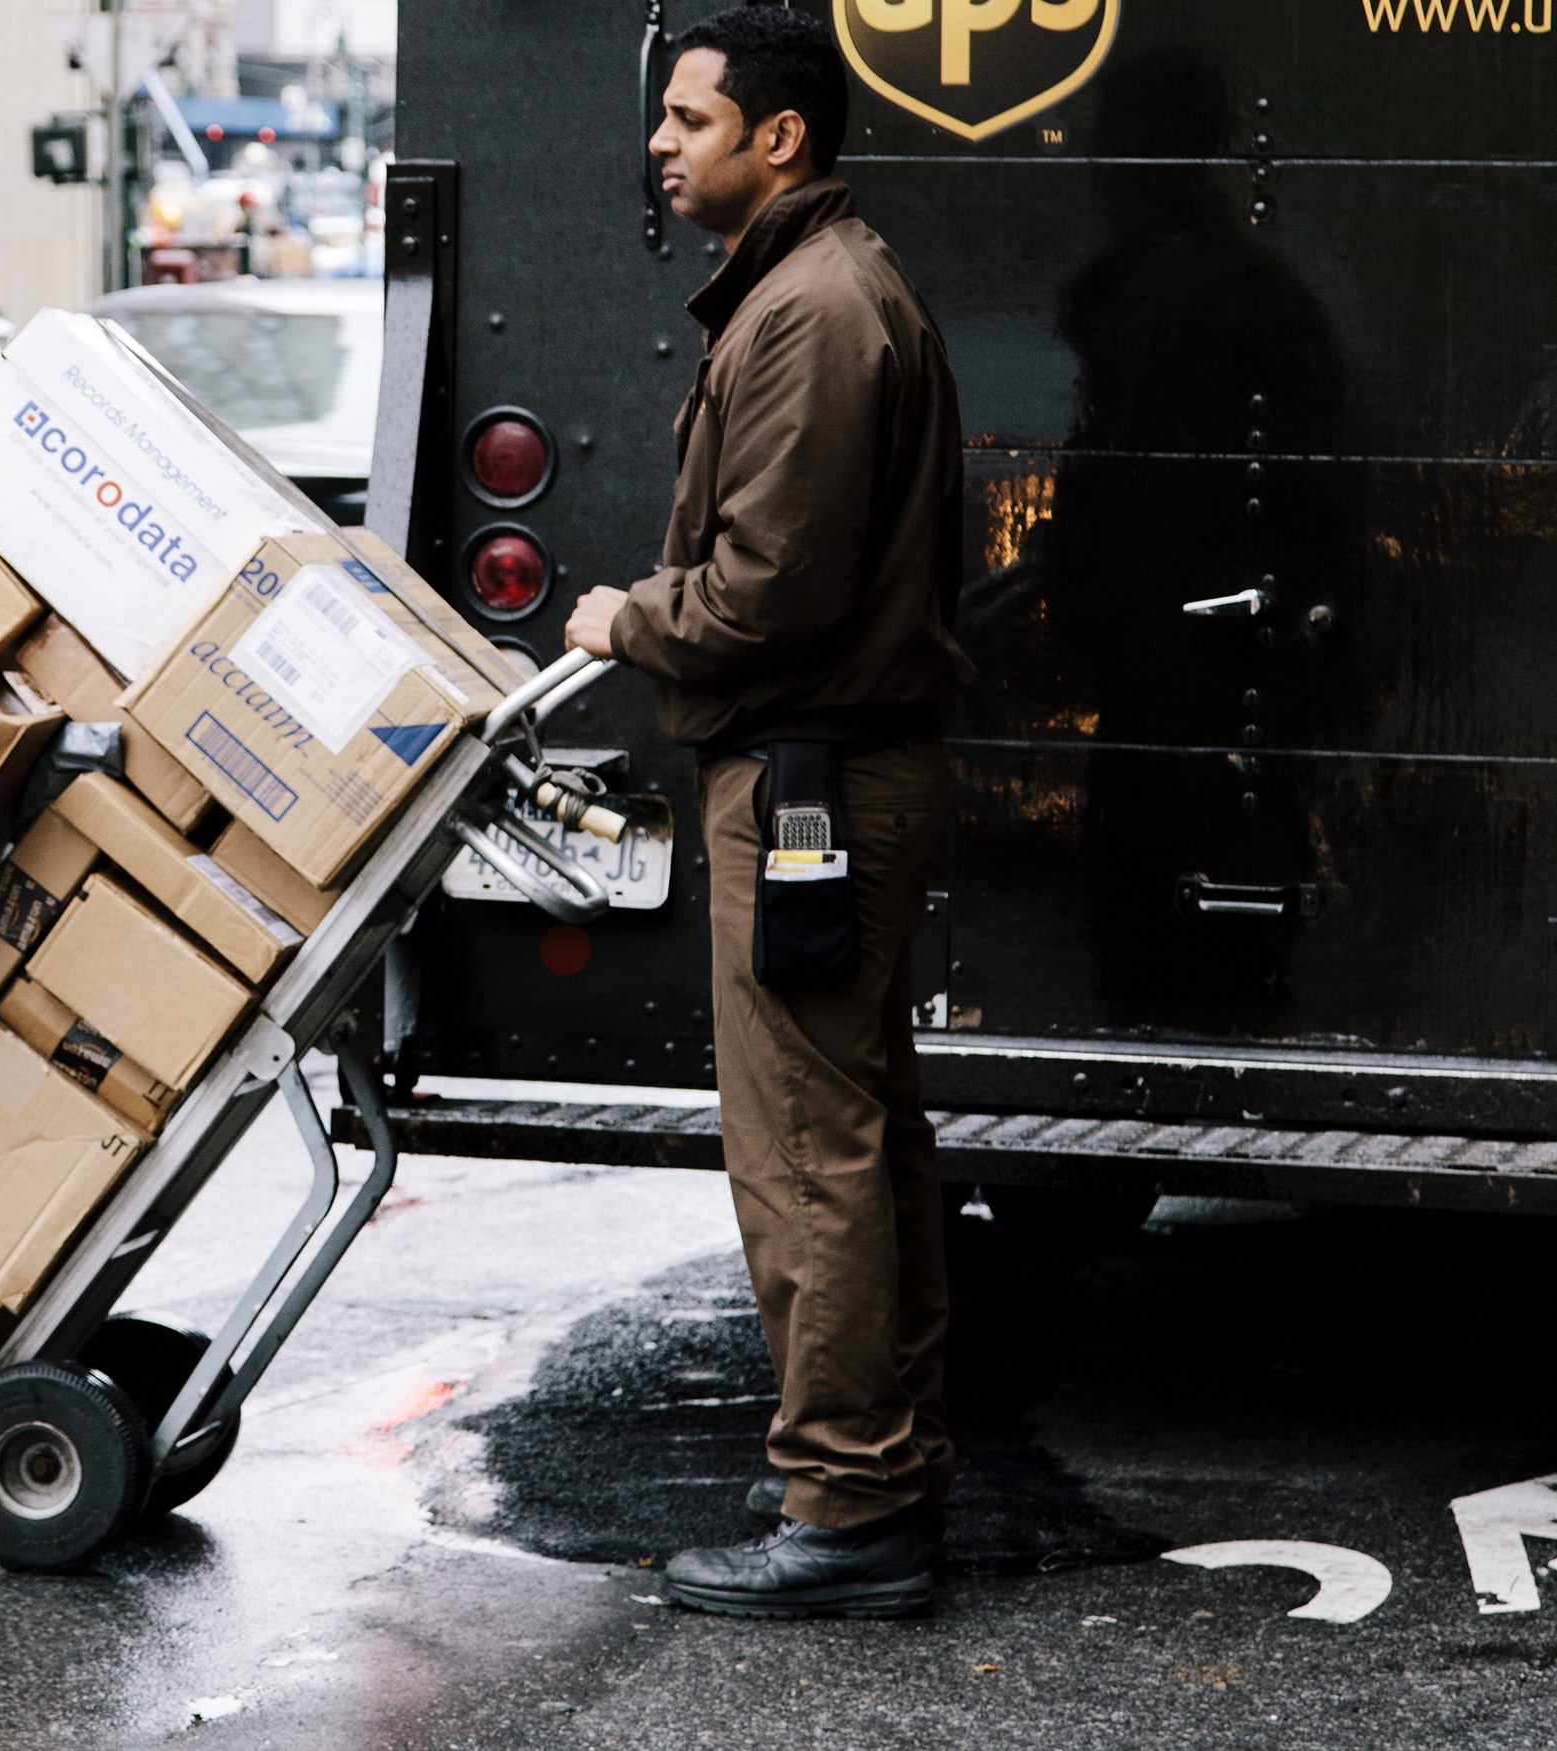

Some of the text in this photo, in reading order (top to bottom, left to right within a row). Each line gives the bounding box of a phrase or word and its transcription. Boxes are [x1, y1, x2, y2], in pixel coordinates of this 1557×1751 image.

[1042, 128, 1064, 144] TM
[63, 364, 230, 522] Records Management
[40, 426, 198, 583] corodata
[240, 558, 283, 600] 20
[101, 1134, 128, 1157] JT
